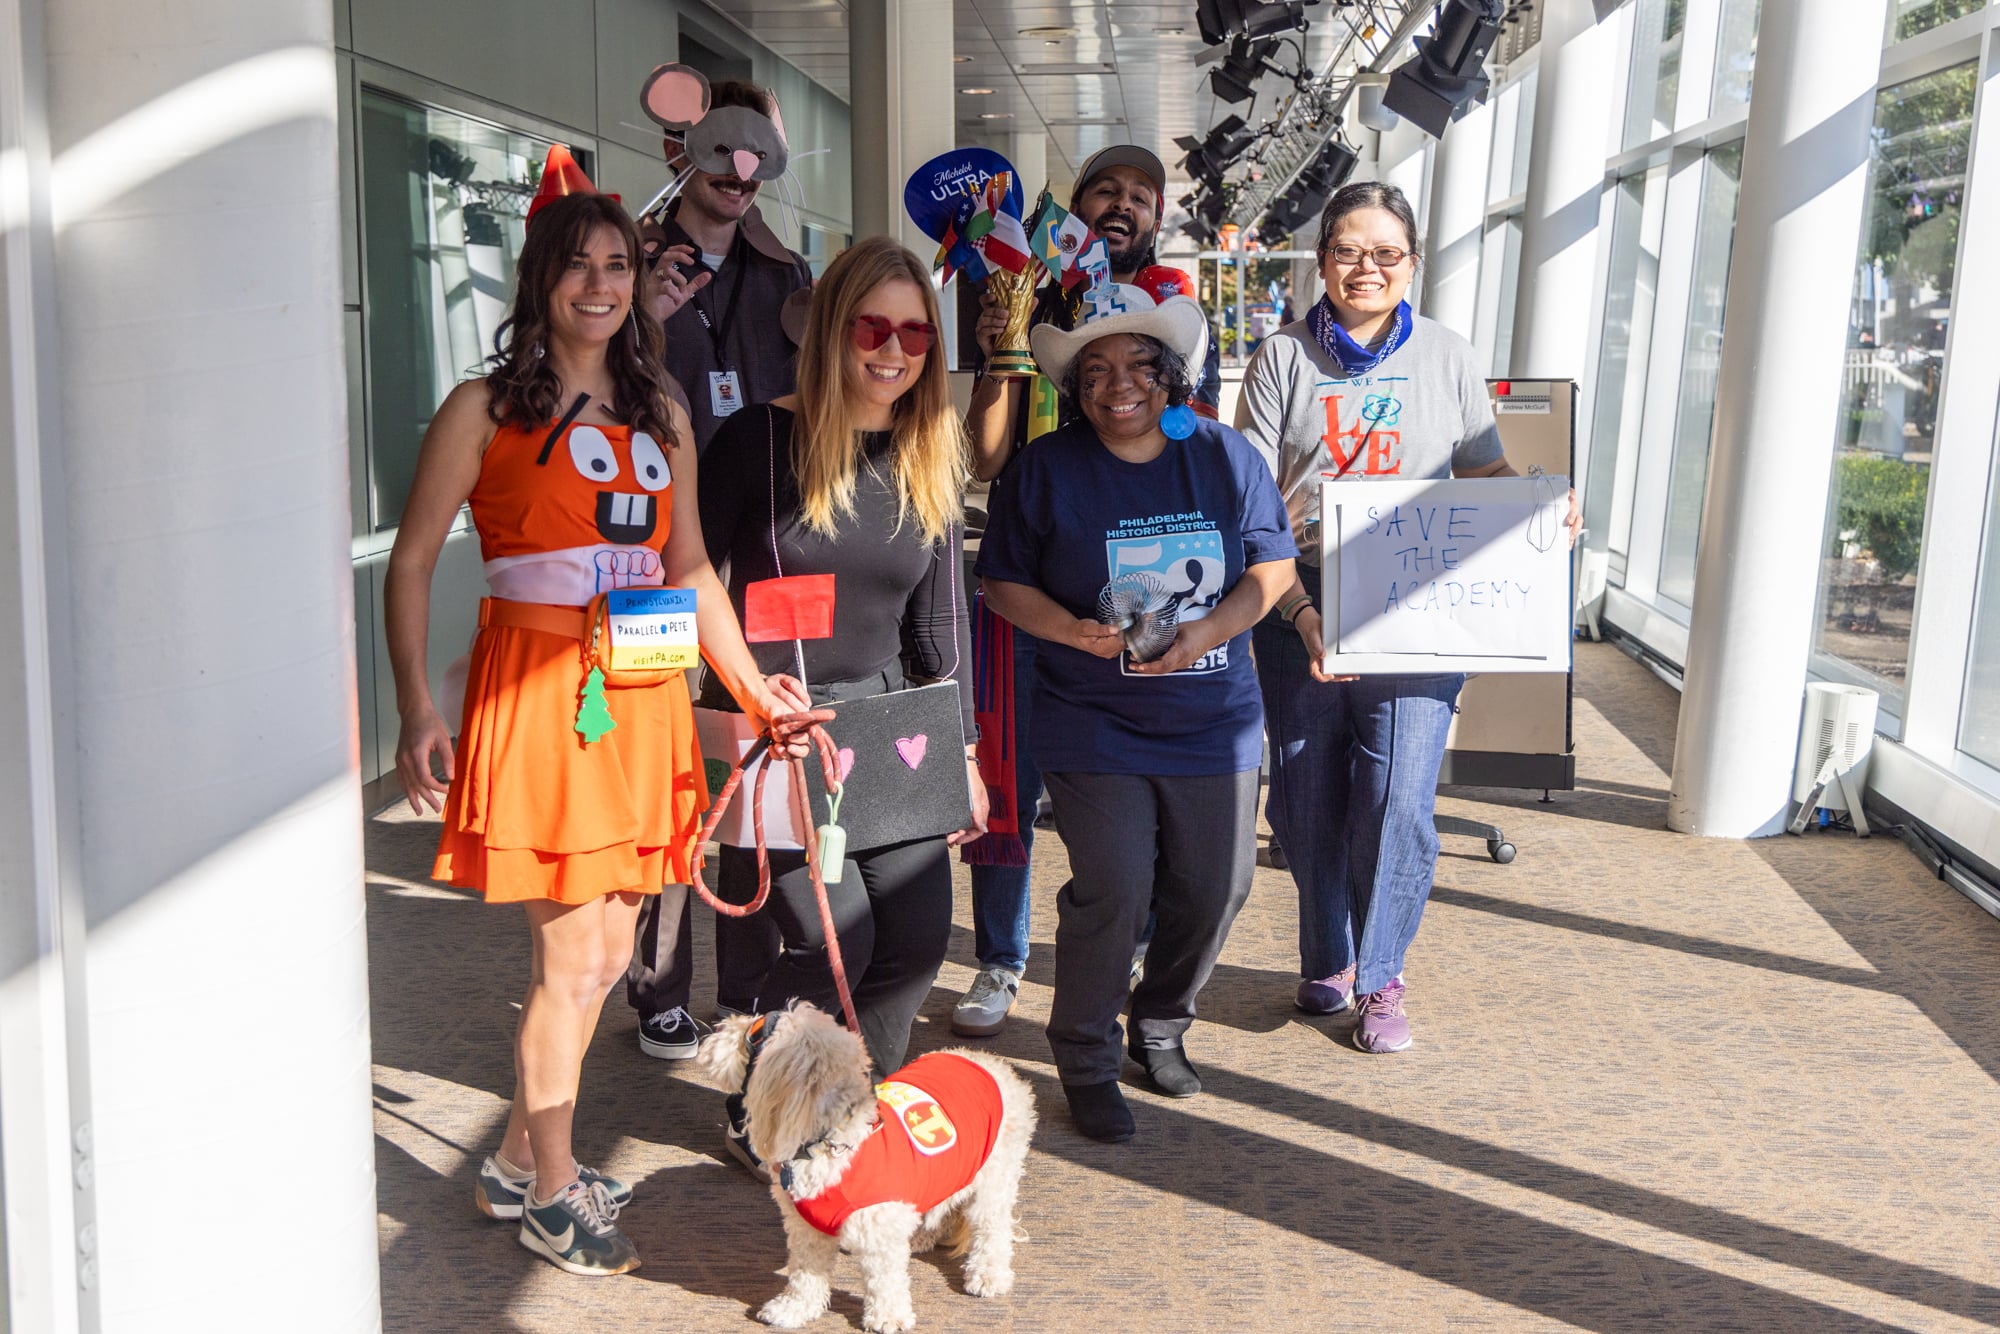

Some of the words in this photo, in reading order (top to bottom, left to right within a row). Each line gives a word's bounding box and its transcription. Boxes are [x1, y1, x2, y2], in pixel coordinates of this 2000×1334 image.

[934, 161, 973, 186] Michelob
[930, 169, 992, 201] ULTRA
[1351, 377, 1373, 387] WE
[1106, 526, 1164, 539] HISTORIC
[1166, 521, 1217, 534] DISTRICT
[1119, 511, 1204, 528] PHILADELPHIA
[1365, 506, 1479, 541] SAVE
[1394, 547, 1462, 572] THE
[1384, 579, 1532, 614] ACADEMY
[617, 624, 659, 636] PARALLEL
[669, 621, 687, 632] PETE
[633, 652, 686, 665] visitPA.com
